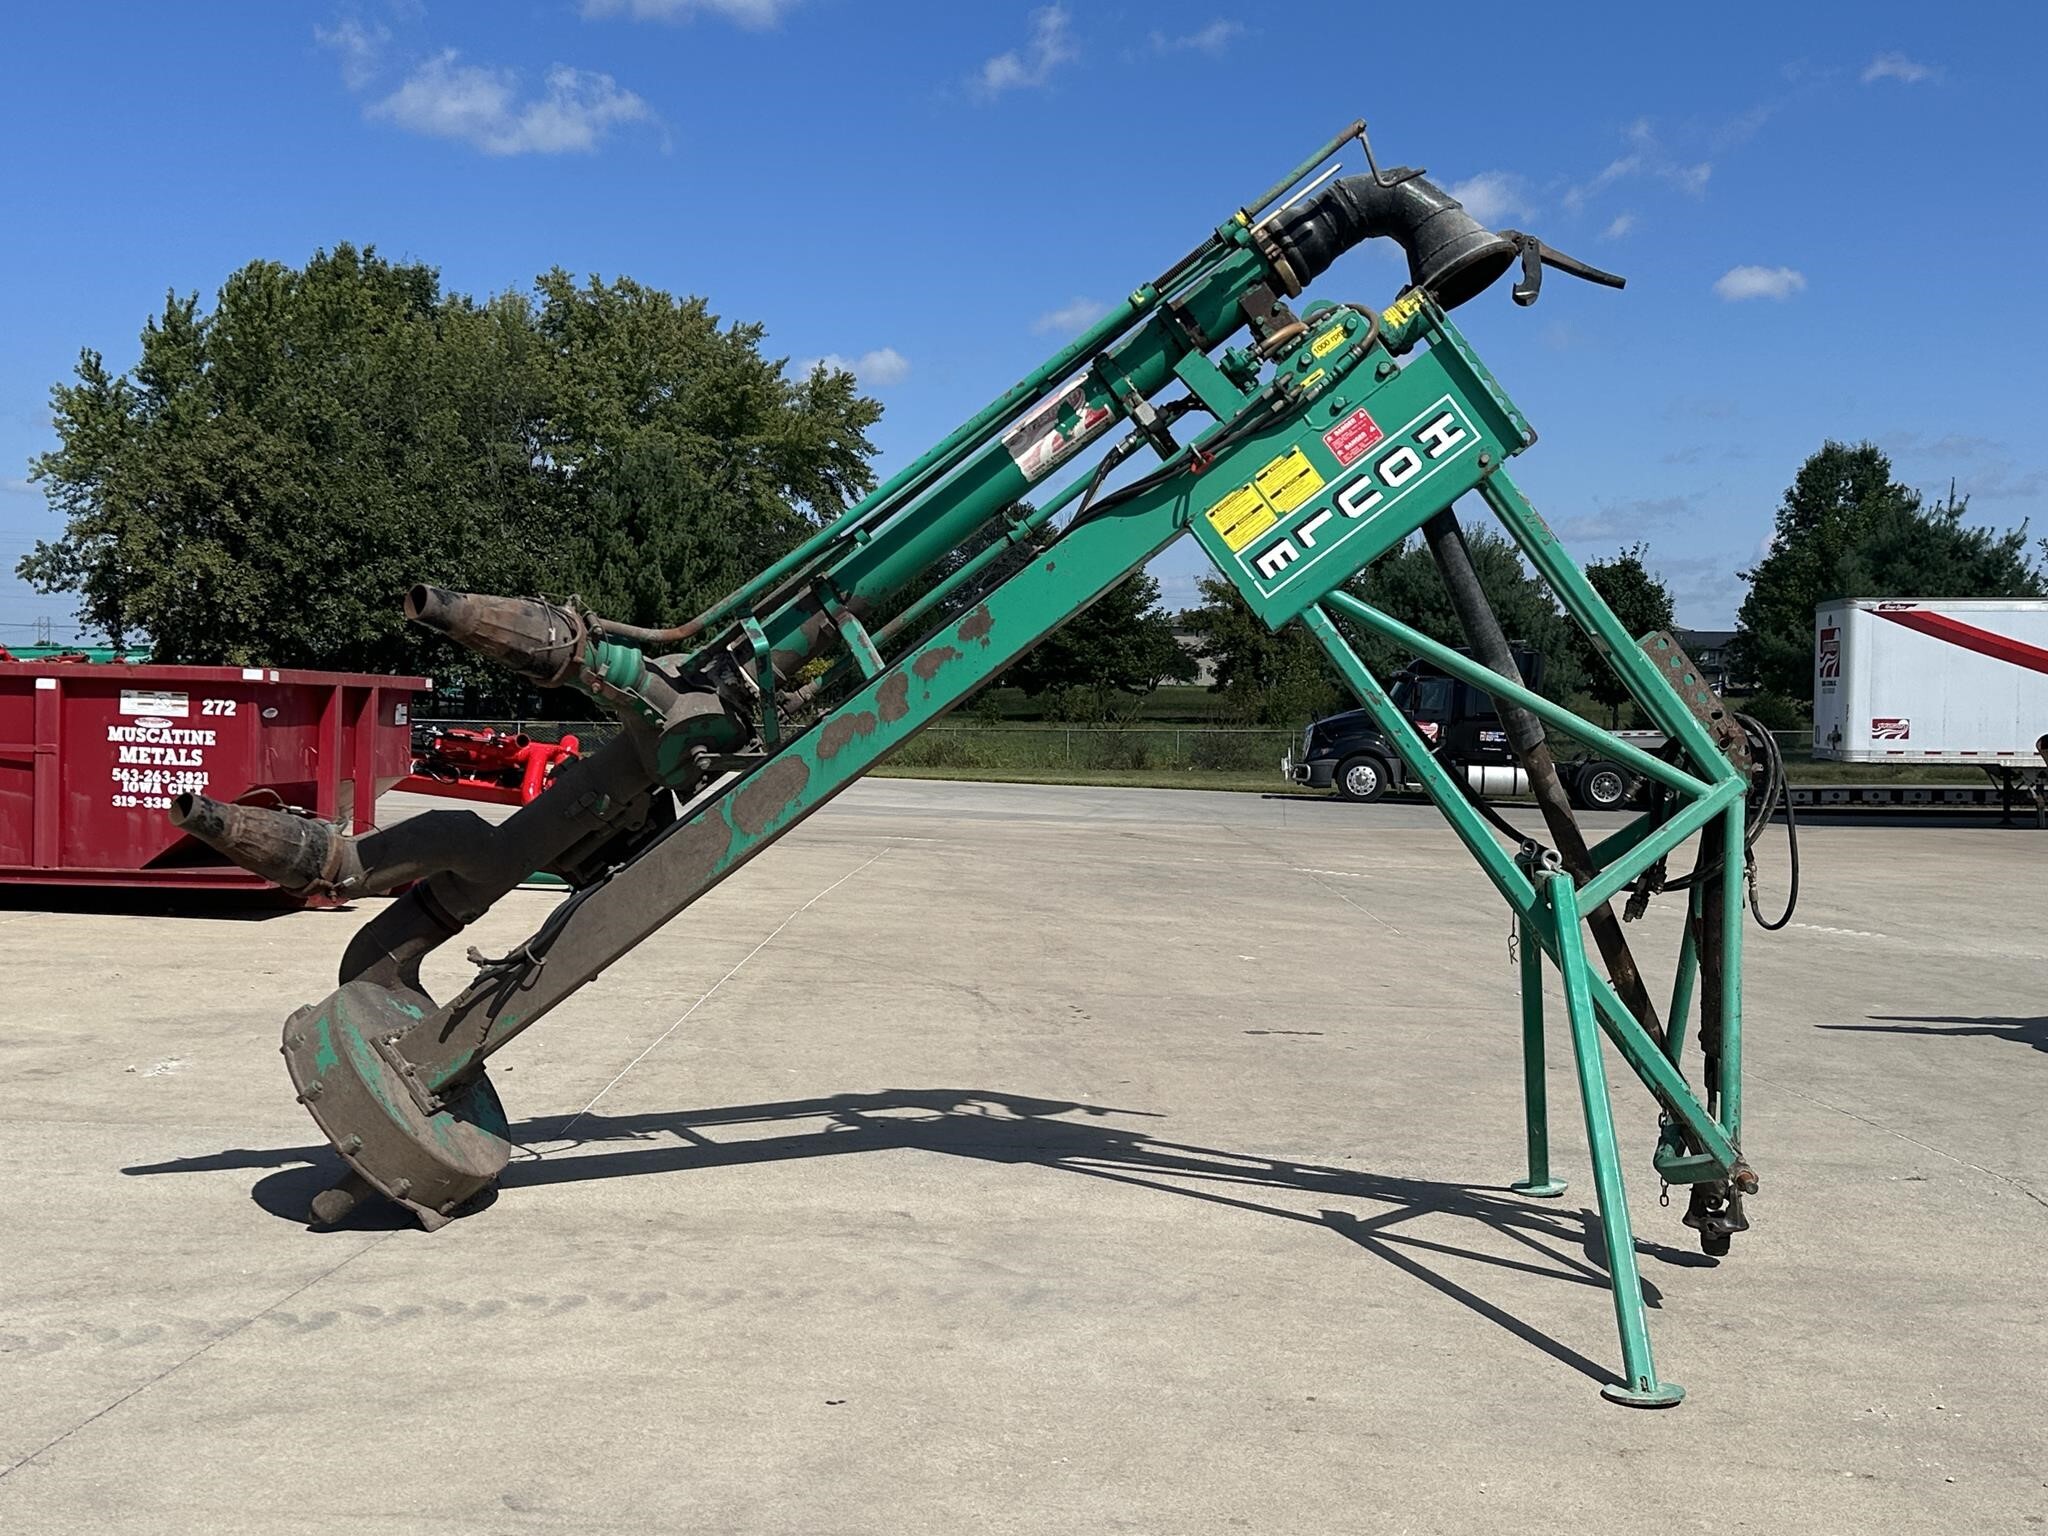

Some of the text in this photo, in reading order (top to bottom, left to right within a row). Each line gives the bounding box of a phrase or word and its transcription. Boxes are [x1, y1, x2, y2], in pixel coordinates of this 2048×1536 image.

[1313, 339, 1331, 354] 1000
[1333, 418, 1357, 436] DANGER
[1344, 431, 1368, 451] DANGER
[1250, 411, 1467, 580] HOULE
[202, 699, 236, 716] 272
[107, 726, 216, 745] MUSCATINE
[119, 746, 203, 766] METALS
[112, 768, 209, 785] 563-263-3821
[121, 781, 204, 796] IOWA CITY
[112, 795, 172, 809] 319-338
